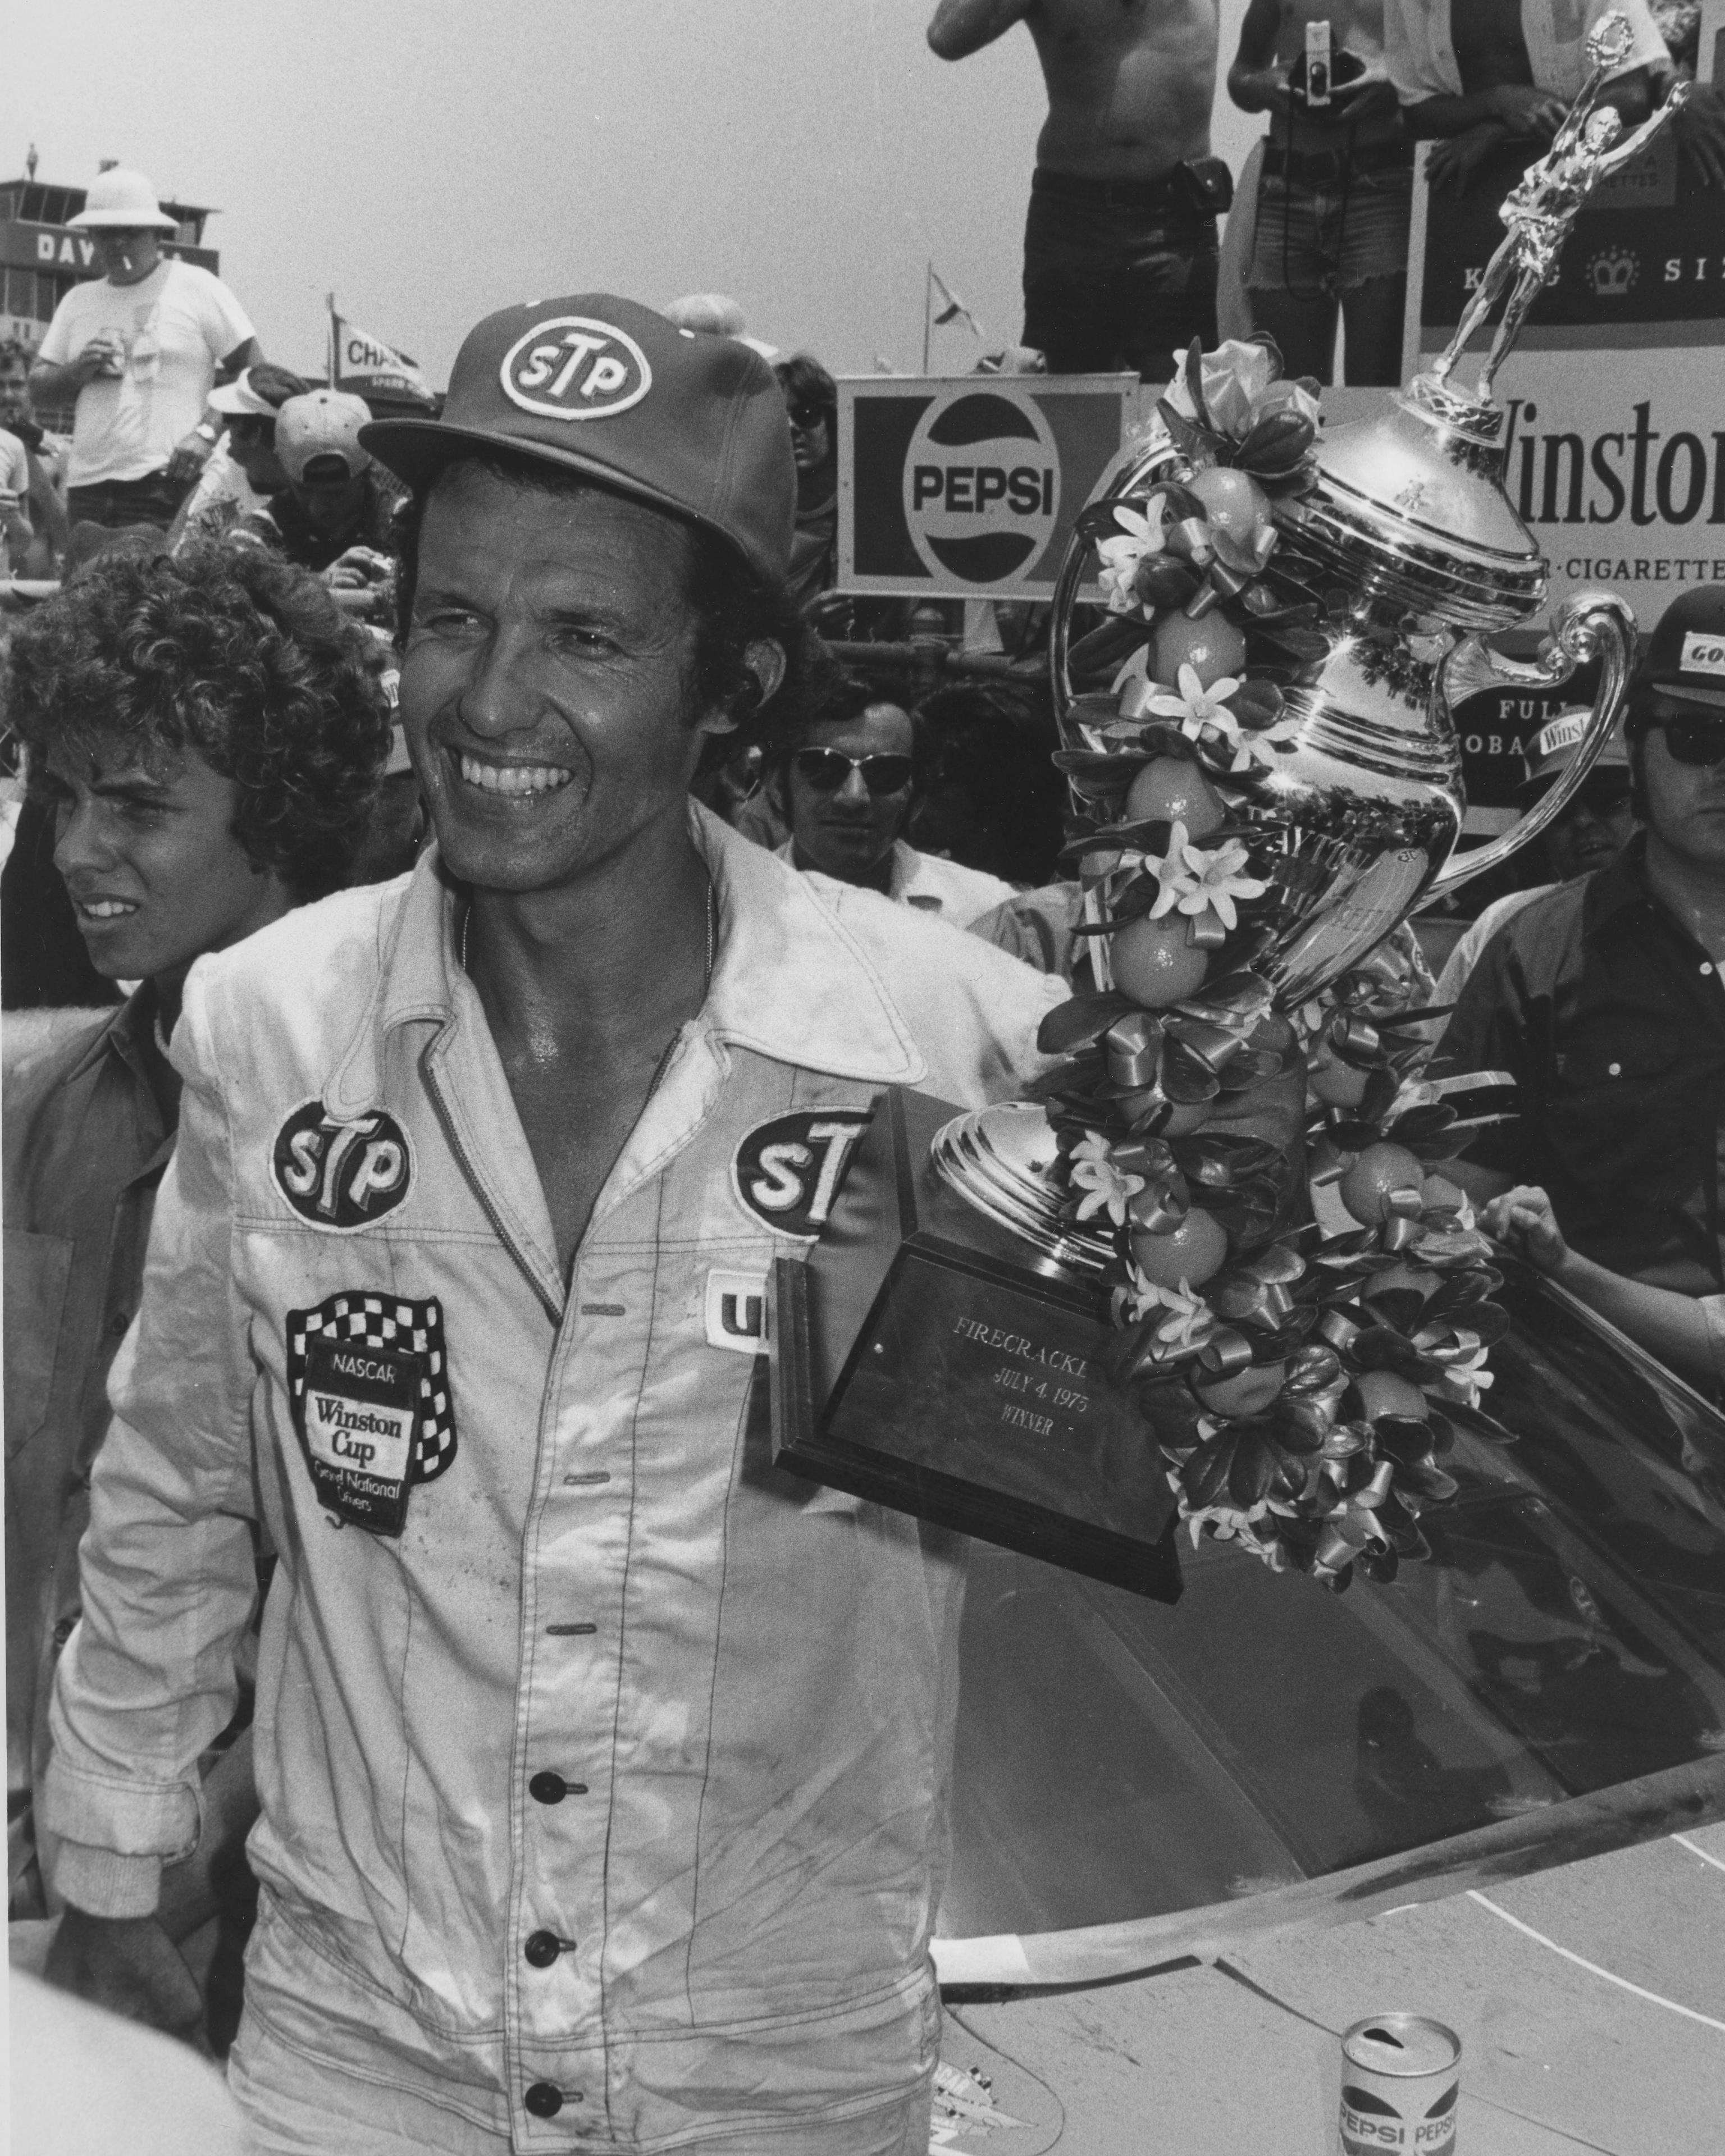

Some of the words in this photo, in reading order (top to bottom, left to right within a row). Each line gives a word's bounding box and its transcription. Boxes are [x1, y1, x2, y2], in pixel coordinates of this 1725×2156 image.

[1664, 257, 1725, 282] SI
[518, 331, 628, 401] STP
[913, 465, 1053, 515] PEPSI
[284, 1117, 407, 1218] STP
[333, 1353, 396, 1384] NASCAR
[993, 1368, 1034, 1392] JULY
[1052, 1387, 1089, 1412] 1975
[315, 1396, 402, 1438] Winston
[1001, 1404, 1054, 1436] WINNER
[332, 1429, 376, 1469] Cup
[346, 1473, 401, 1499] National
